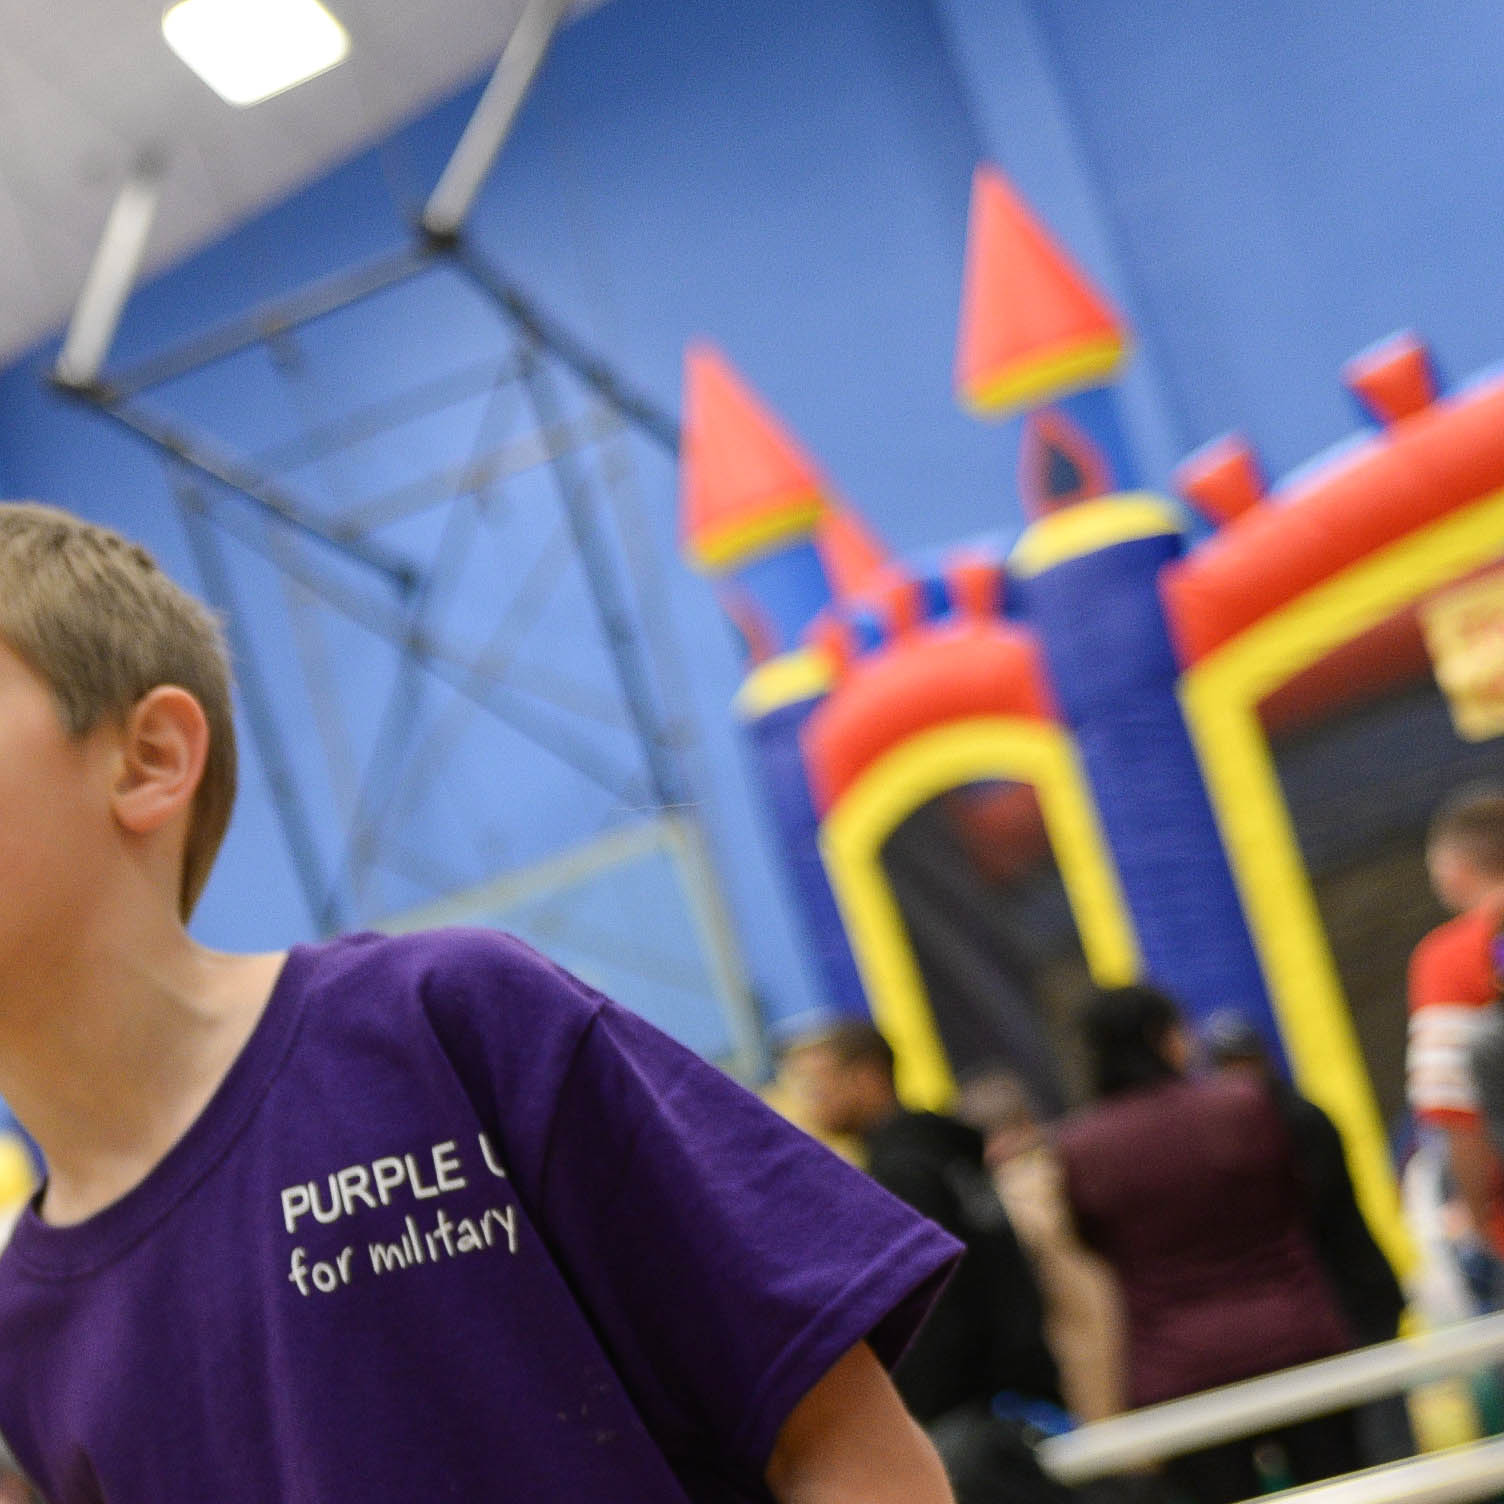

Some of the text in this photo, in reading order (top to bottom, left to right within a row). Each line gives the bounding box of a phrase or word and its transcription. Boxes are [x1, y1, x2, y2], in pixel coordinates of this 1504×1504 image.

[280, 1140, 467, 1234] PURPLE
[288, 1204, 520, 1297] for military
